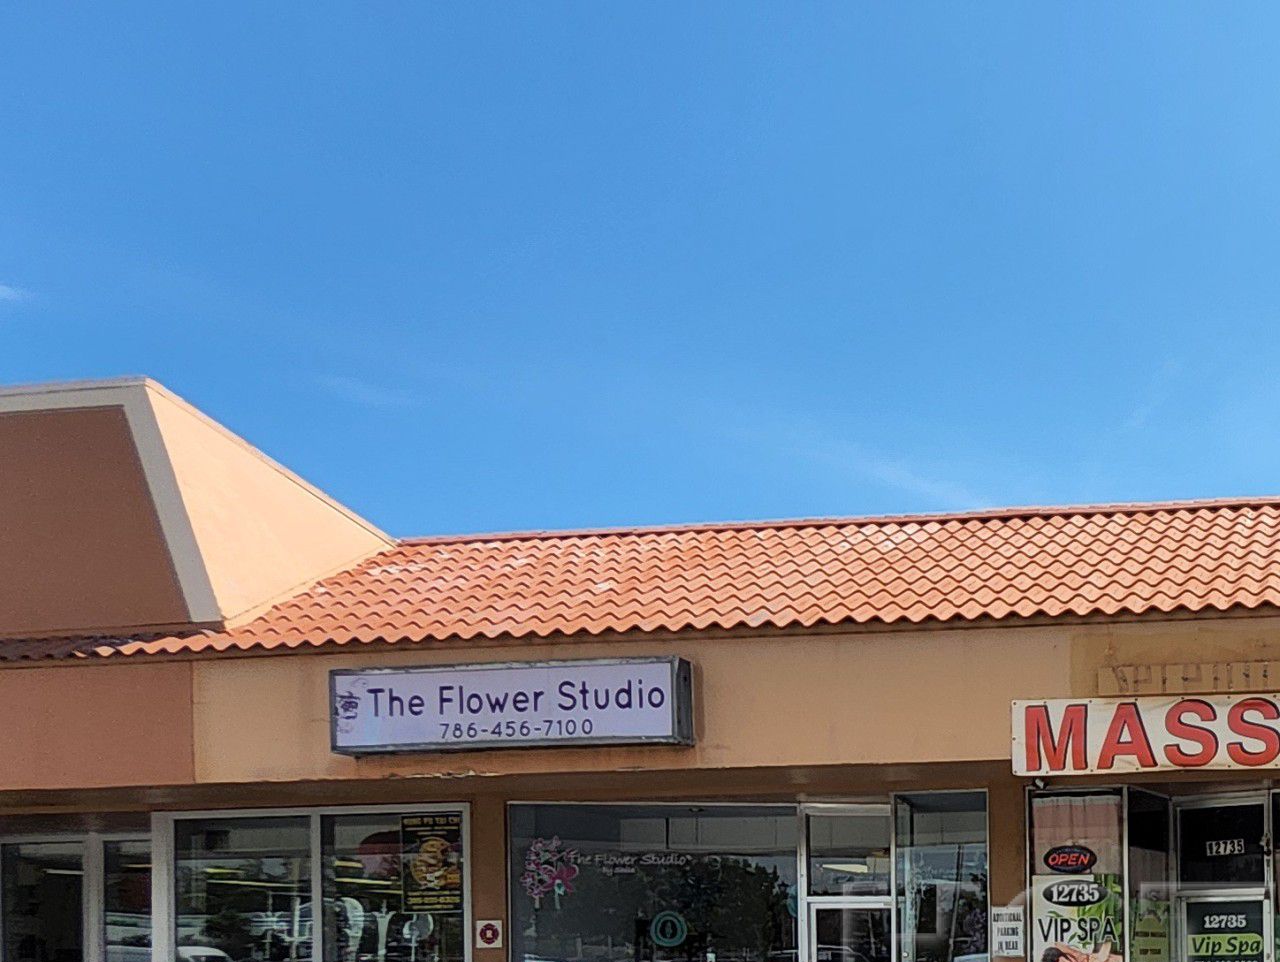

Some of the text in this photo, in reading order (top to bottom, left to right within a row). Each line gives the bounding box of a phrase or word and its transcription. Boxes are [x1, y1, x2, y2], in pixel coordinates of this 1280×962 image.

[367, 679, 665, 717] The Flower Studio
[440, 719, 593, 739] 786-456-7100
[1208, 840, 1244, 855] 12735
[594, 853, 637, 864] Flower
[640, 853, 687, 865] Studio
[1048, 854, 1090, 866] OPEN
[1050, 884, 1100, 903] 12735
[1038, 917, 1117, 942] VIP SPA
[1204, 915, 1246, 928] 12735
[1193, 936, 1261, 956] Vip Spa
